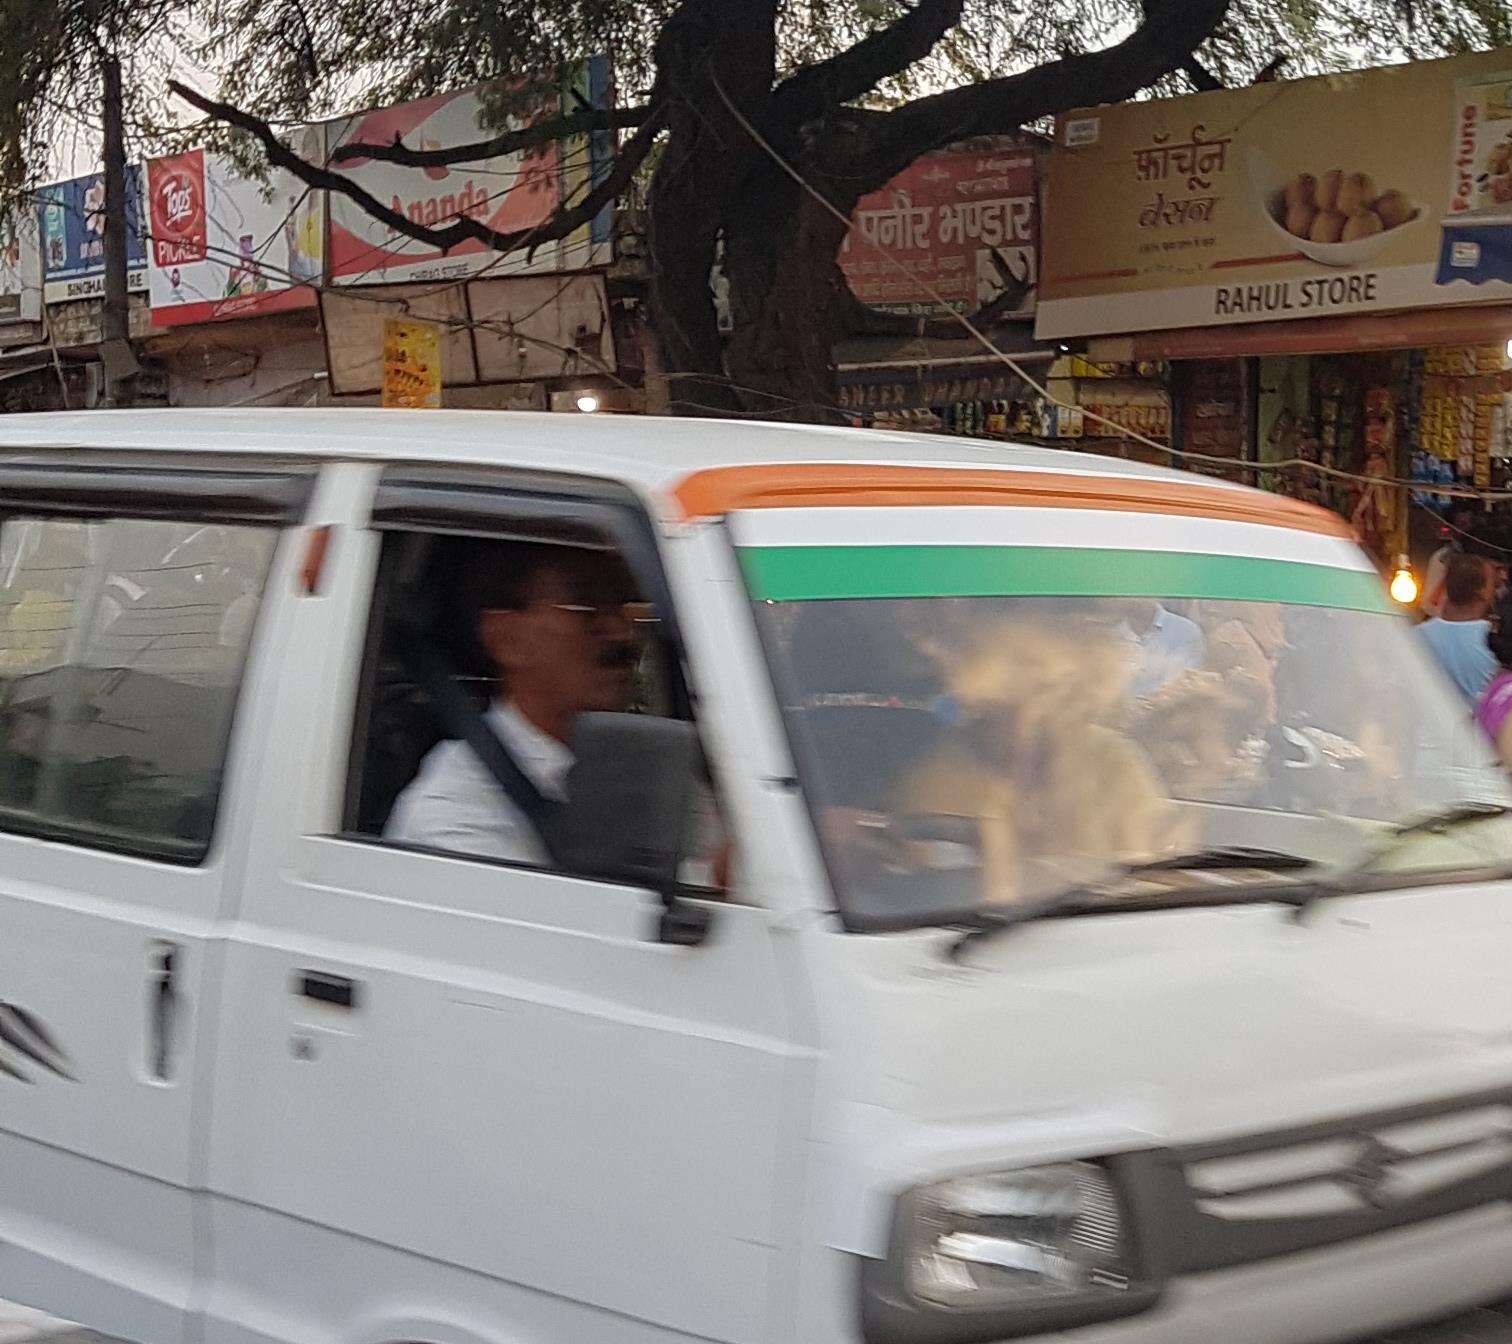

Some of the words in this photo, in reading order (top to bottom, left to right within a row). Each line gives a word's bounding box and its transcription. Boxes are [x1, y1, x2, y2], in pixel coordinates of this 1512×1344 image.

[1452, 105, 1478, 212] Fortune
[857, 188, 934, 250] पनीर
[1214, 282, 1294, 315] RAHUL
[1299, 273, 1377, 307] STORE
